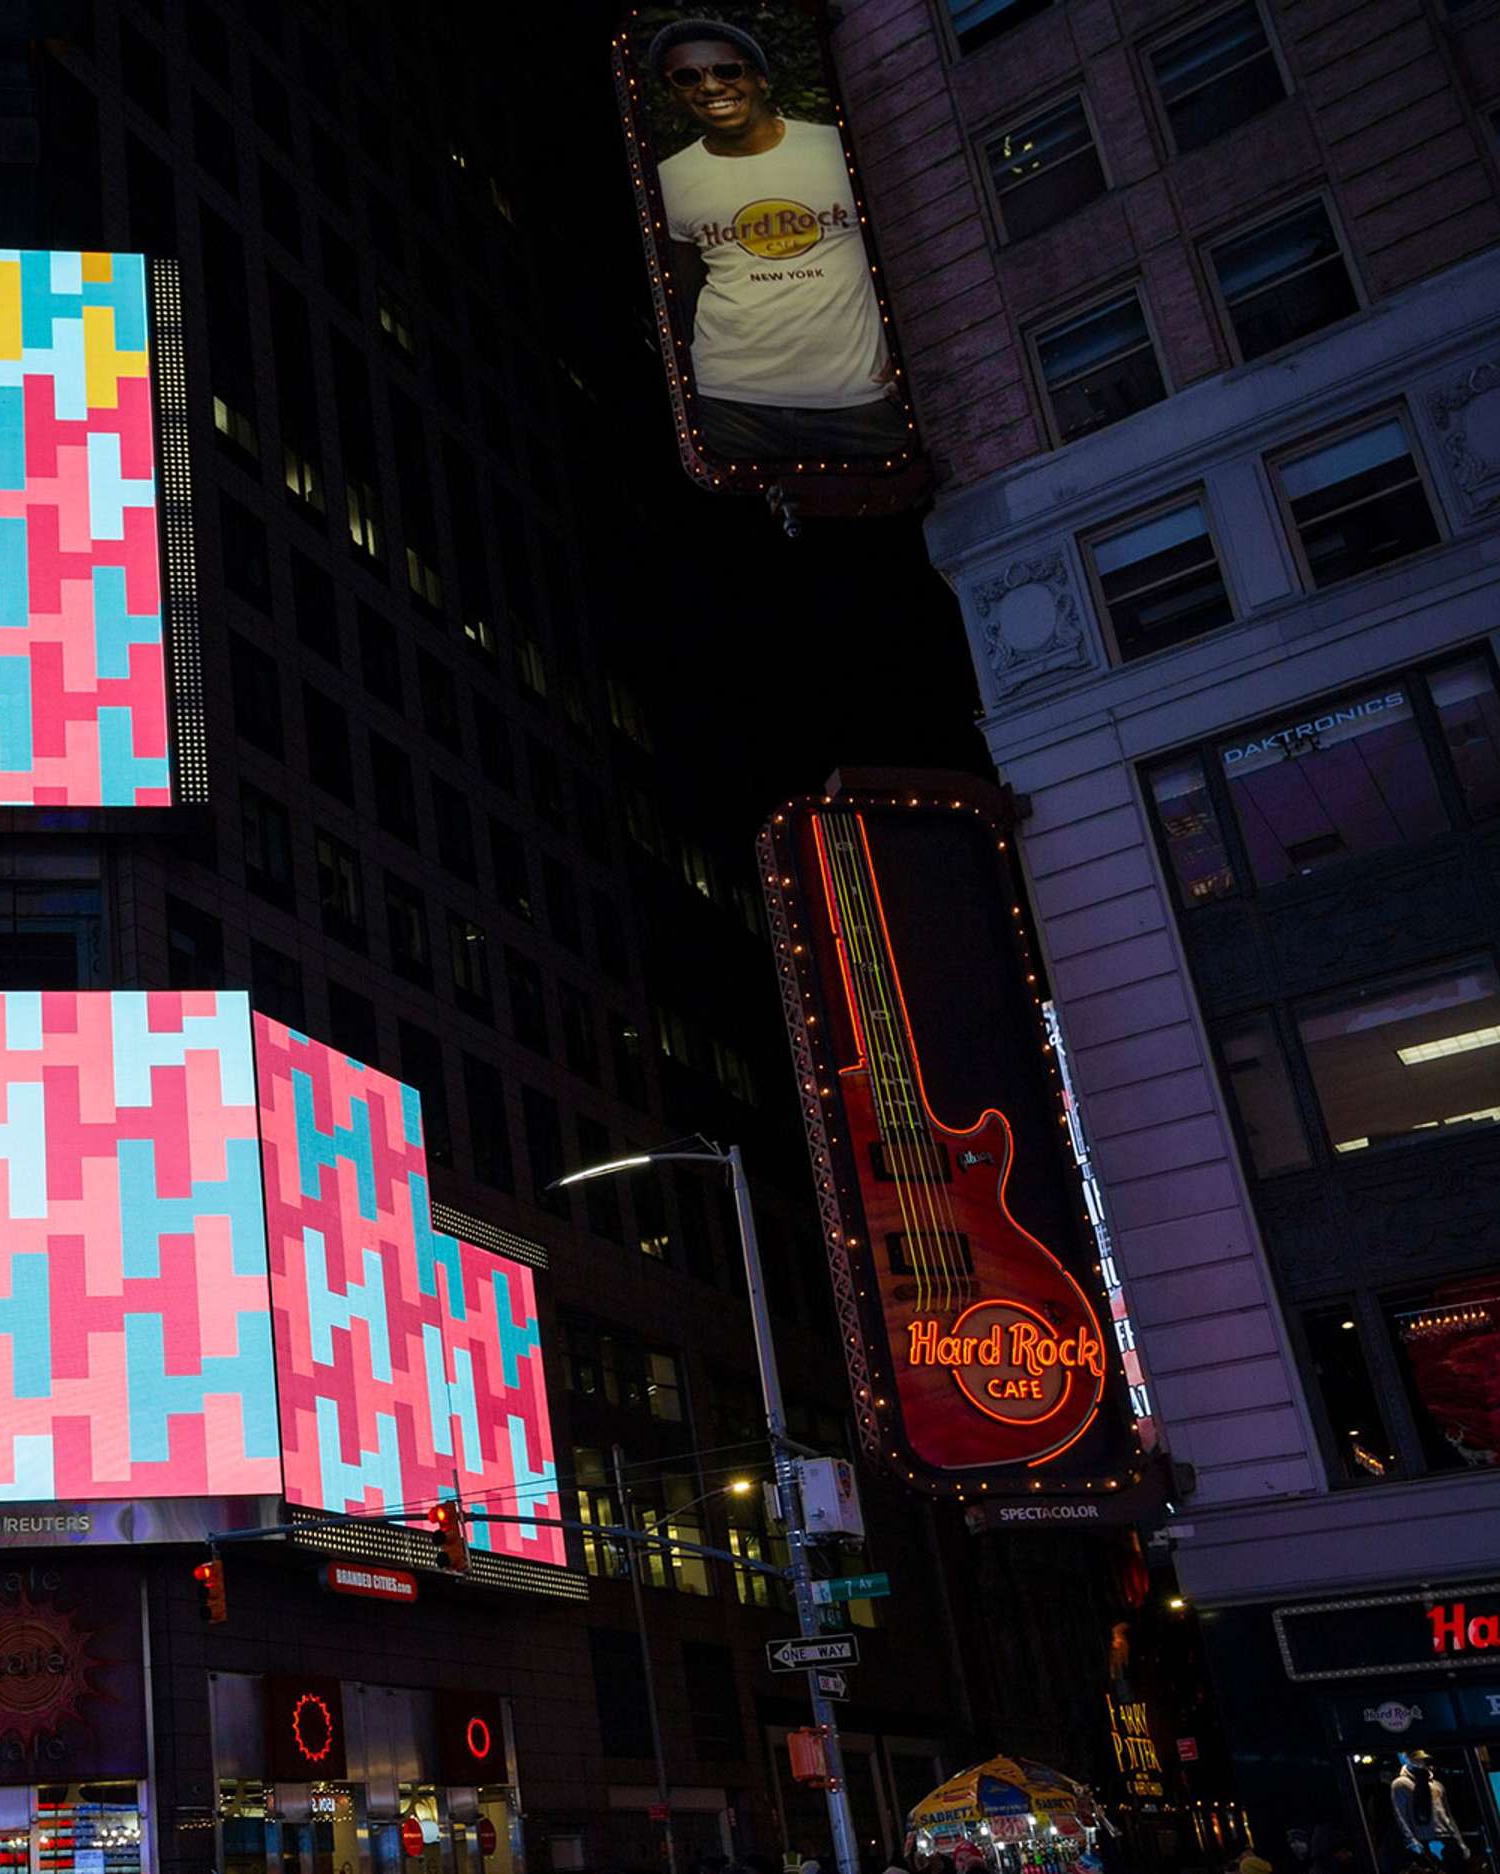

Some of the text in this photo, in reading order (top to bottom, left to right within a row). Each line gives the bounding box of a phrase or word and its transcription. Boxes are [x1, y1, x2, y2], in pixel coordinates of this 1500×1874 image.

[701, 203, 849, 246] Hard Rock
[750, 268, 824, 282] NEW YORK
[1223, 692, 1404, 765] DAKTRONICS
[907, 1320, 1002, 1366] Hard
[1008, 1321, 1105, 1376] Rock
[986, 1378, 1044, 1400] CAFE
[1000, 1505, 1100, 1521] SPECTACOLOR
[7, 1515, 91, 1533] REUTERS
[844, 1580, 853, 1598] 7
[782, 1645, 845, 1661] ONE WAY
